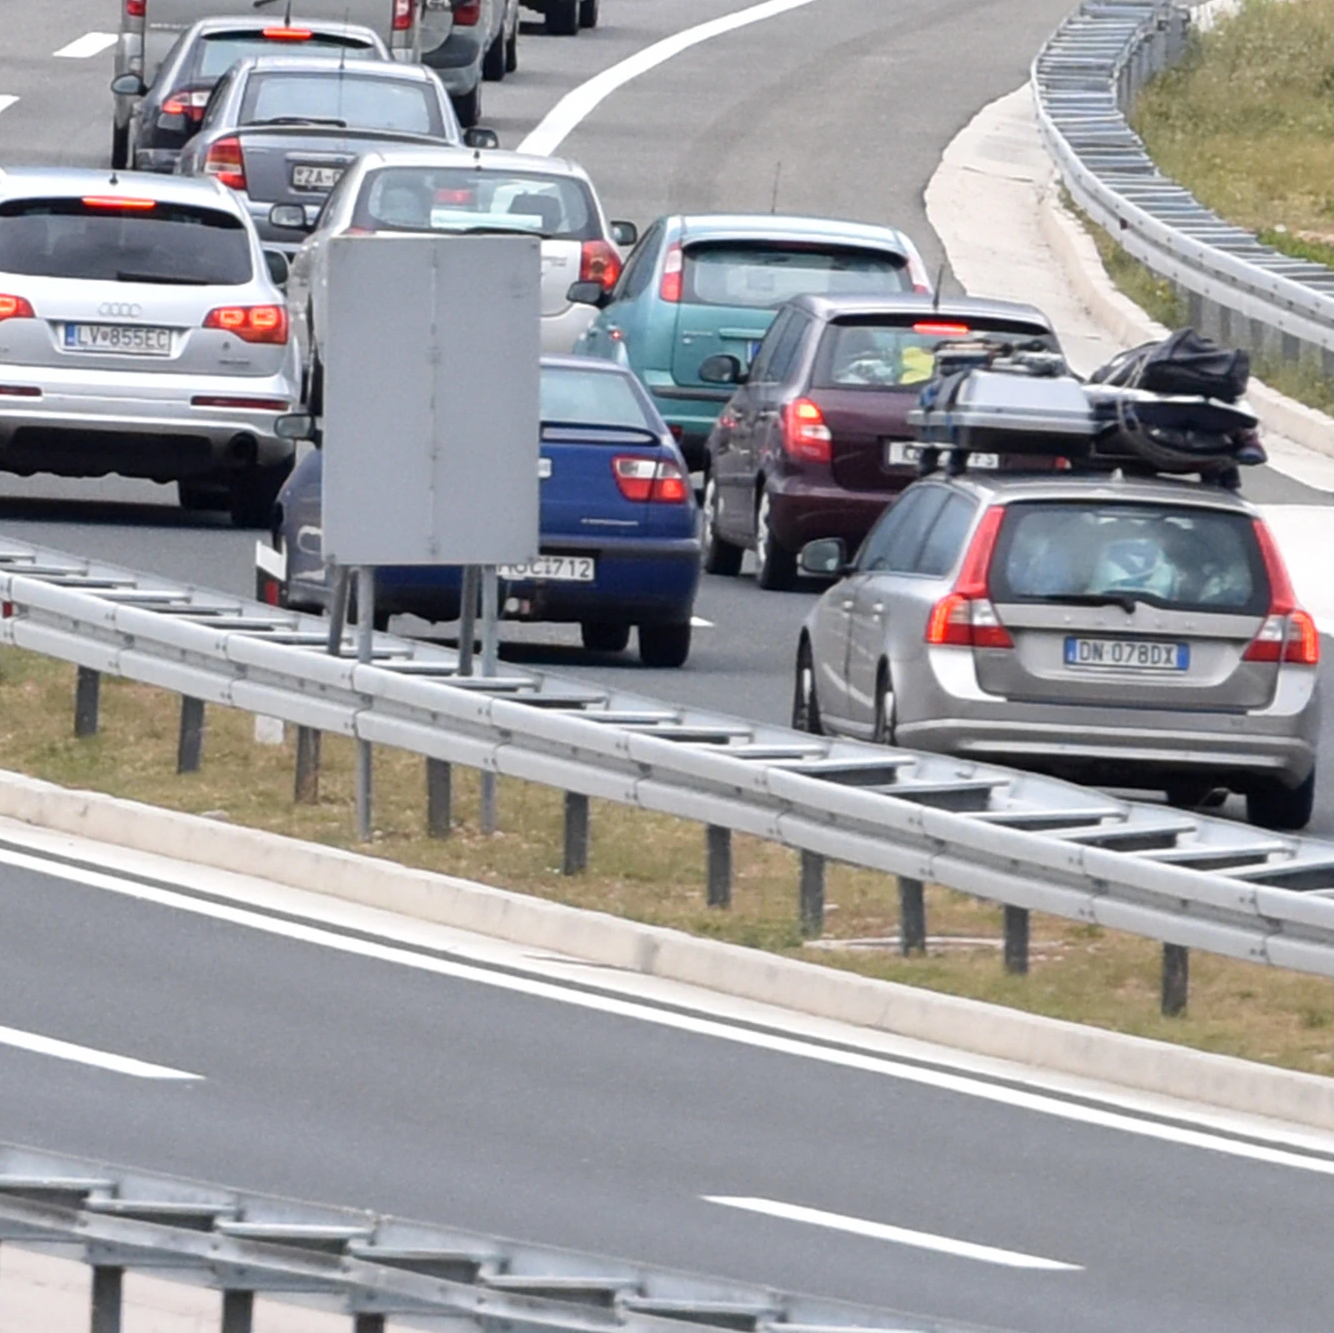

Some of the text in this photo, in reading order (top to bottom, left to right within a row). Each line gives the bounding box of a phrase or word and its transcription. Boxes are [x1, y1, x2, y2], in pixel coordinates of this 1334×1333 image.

[78, 325, 168, 349] LV 855EC
[552, 558, 591, 578] 712
[1079, 640, 1104, 662] DN
